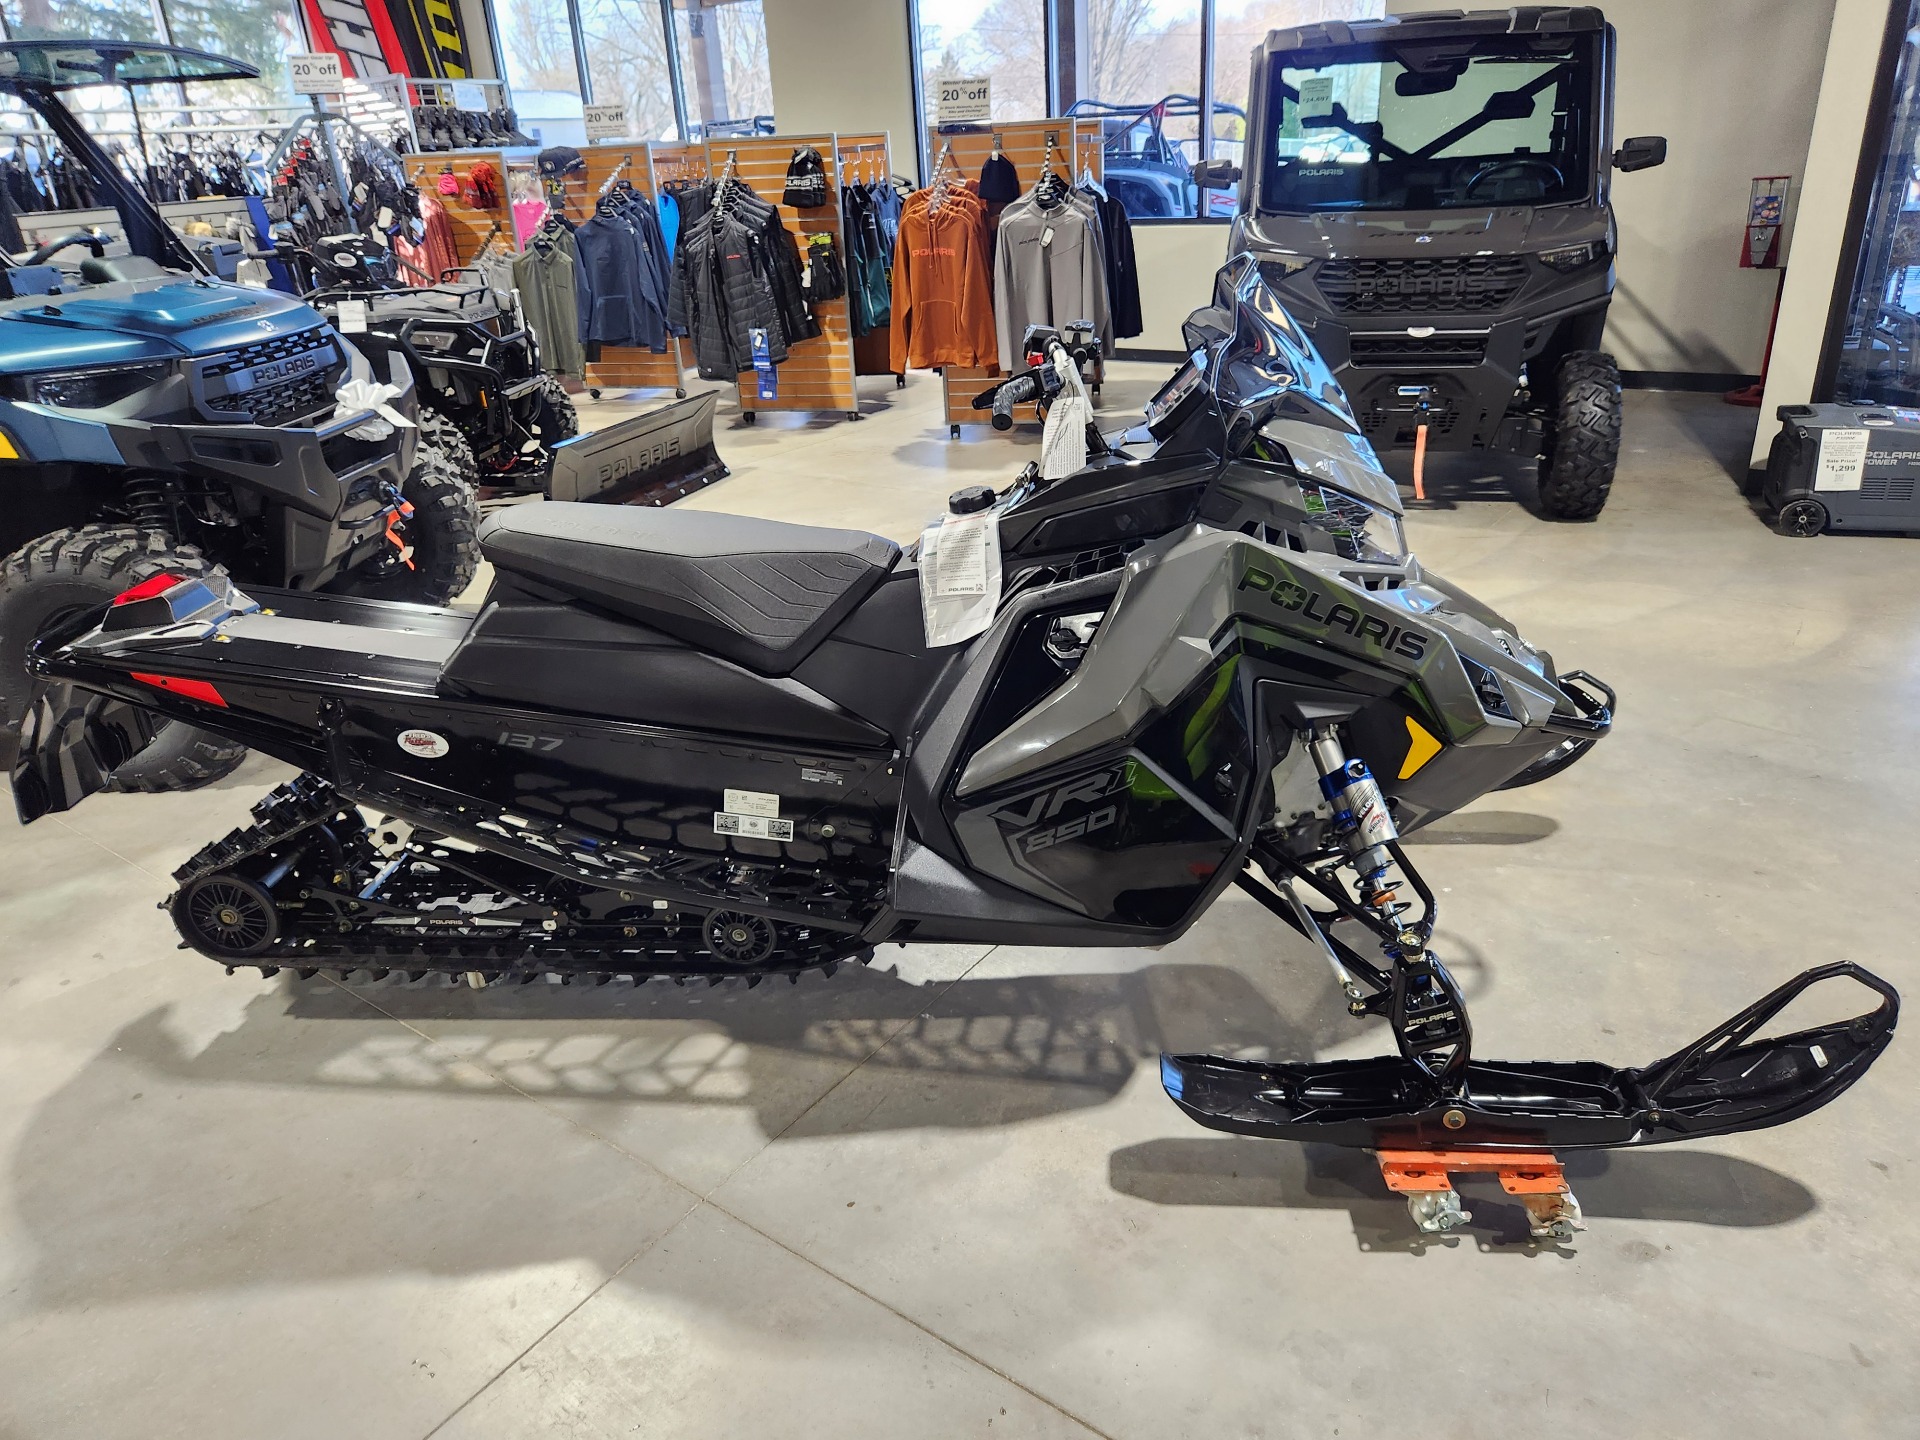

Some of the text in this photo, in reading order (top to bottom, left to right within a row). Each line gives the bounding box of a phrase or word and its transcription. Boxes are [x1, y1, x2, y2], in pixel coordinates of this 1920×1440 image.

[319, 63, 337, 75] off
[968, 87, 988, 100] off
[608, 111, 623, 122] off
[1298, 168, 1345, 177] POLARIS
[911, 247, 956, 258] POLARIS
[1355, 276, 1487, 294] POLARIS
[252, 354, 316, 385] POLARIS
[598, 437, 681, 489] POLARIS
[1826, 464, 1856, 472] $1,299
[1237, 565, 1428, 662] POLARIS
[498, 731, 564, 751] 137
[1025, 804, 1118, 853] 850
[1408, 1010, 1455, 1026] POLARIS
